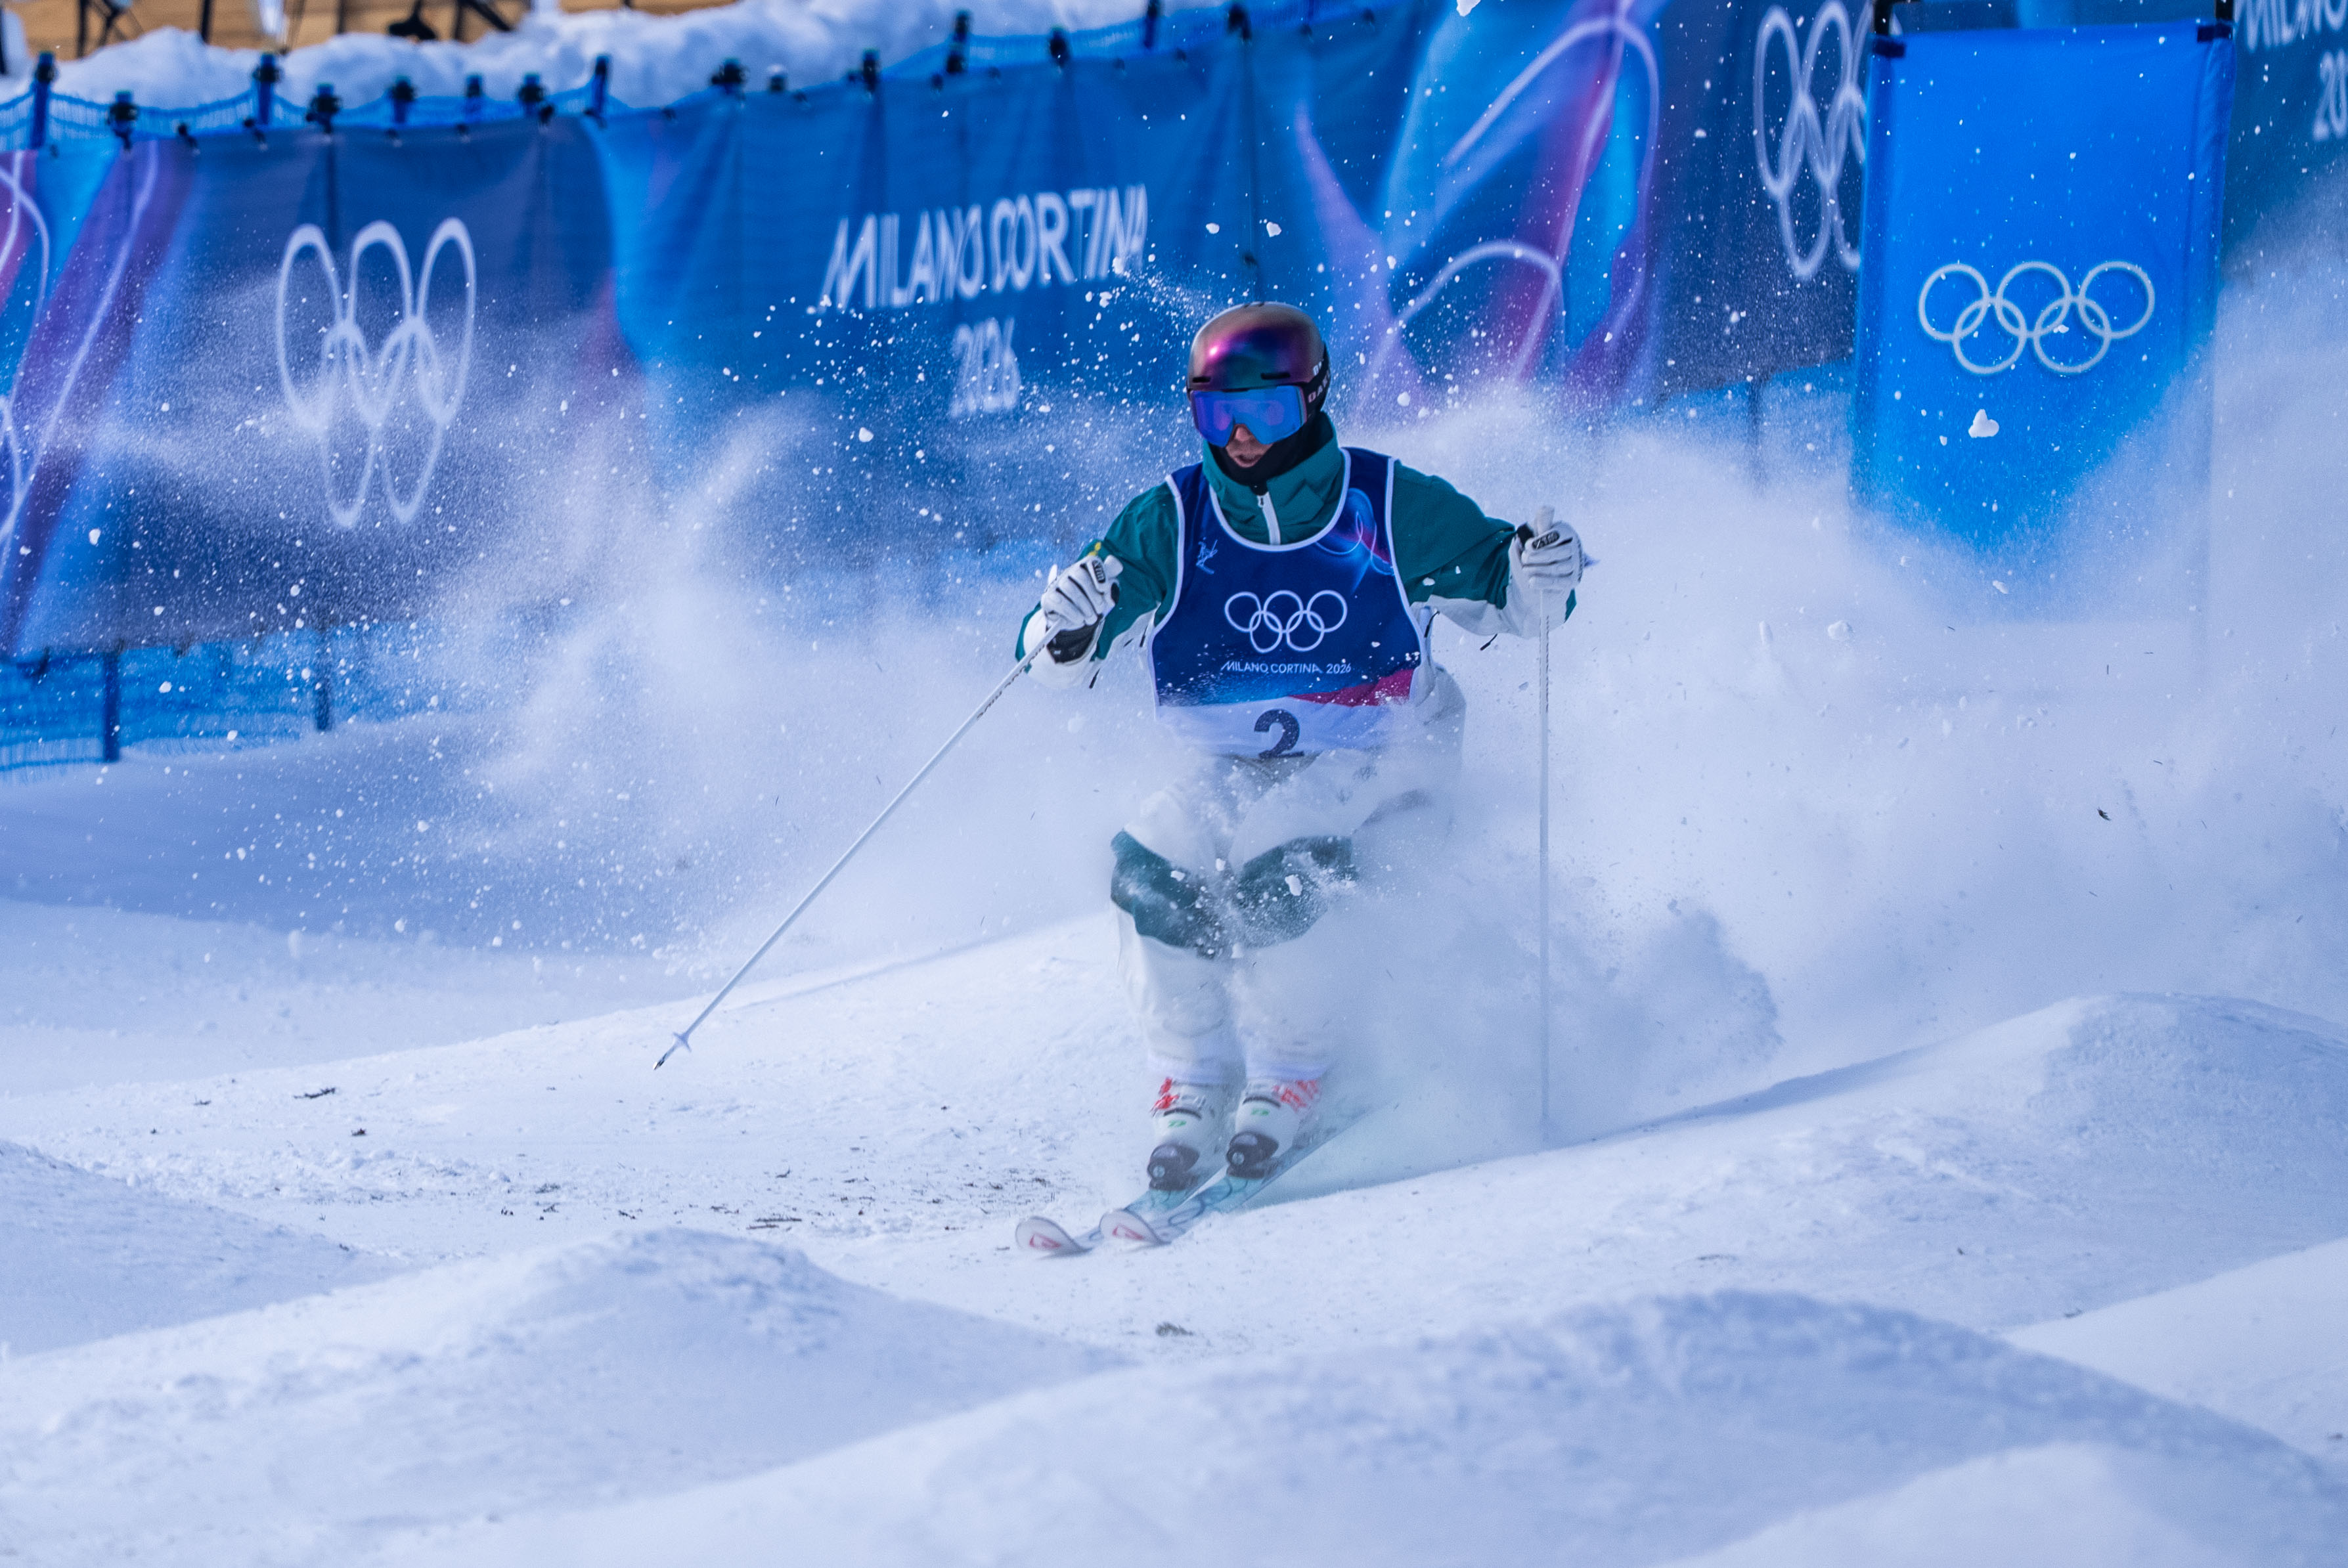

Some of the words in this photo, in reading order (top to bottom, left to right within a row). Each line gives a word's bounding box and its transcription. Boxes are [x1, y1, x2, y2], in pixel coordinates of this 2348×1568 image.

[816, 204, 983, 314] MILANO
[990, 183, 1148, 294] CORTINA
[1220, 661, 1268, 672] MILANO
[1271, 663, 1323, 674] CORTINA
[1326, 663, 1352, 674] 2026
[1254, 708, 1305, 758] 2
